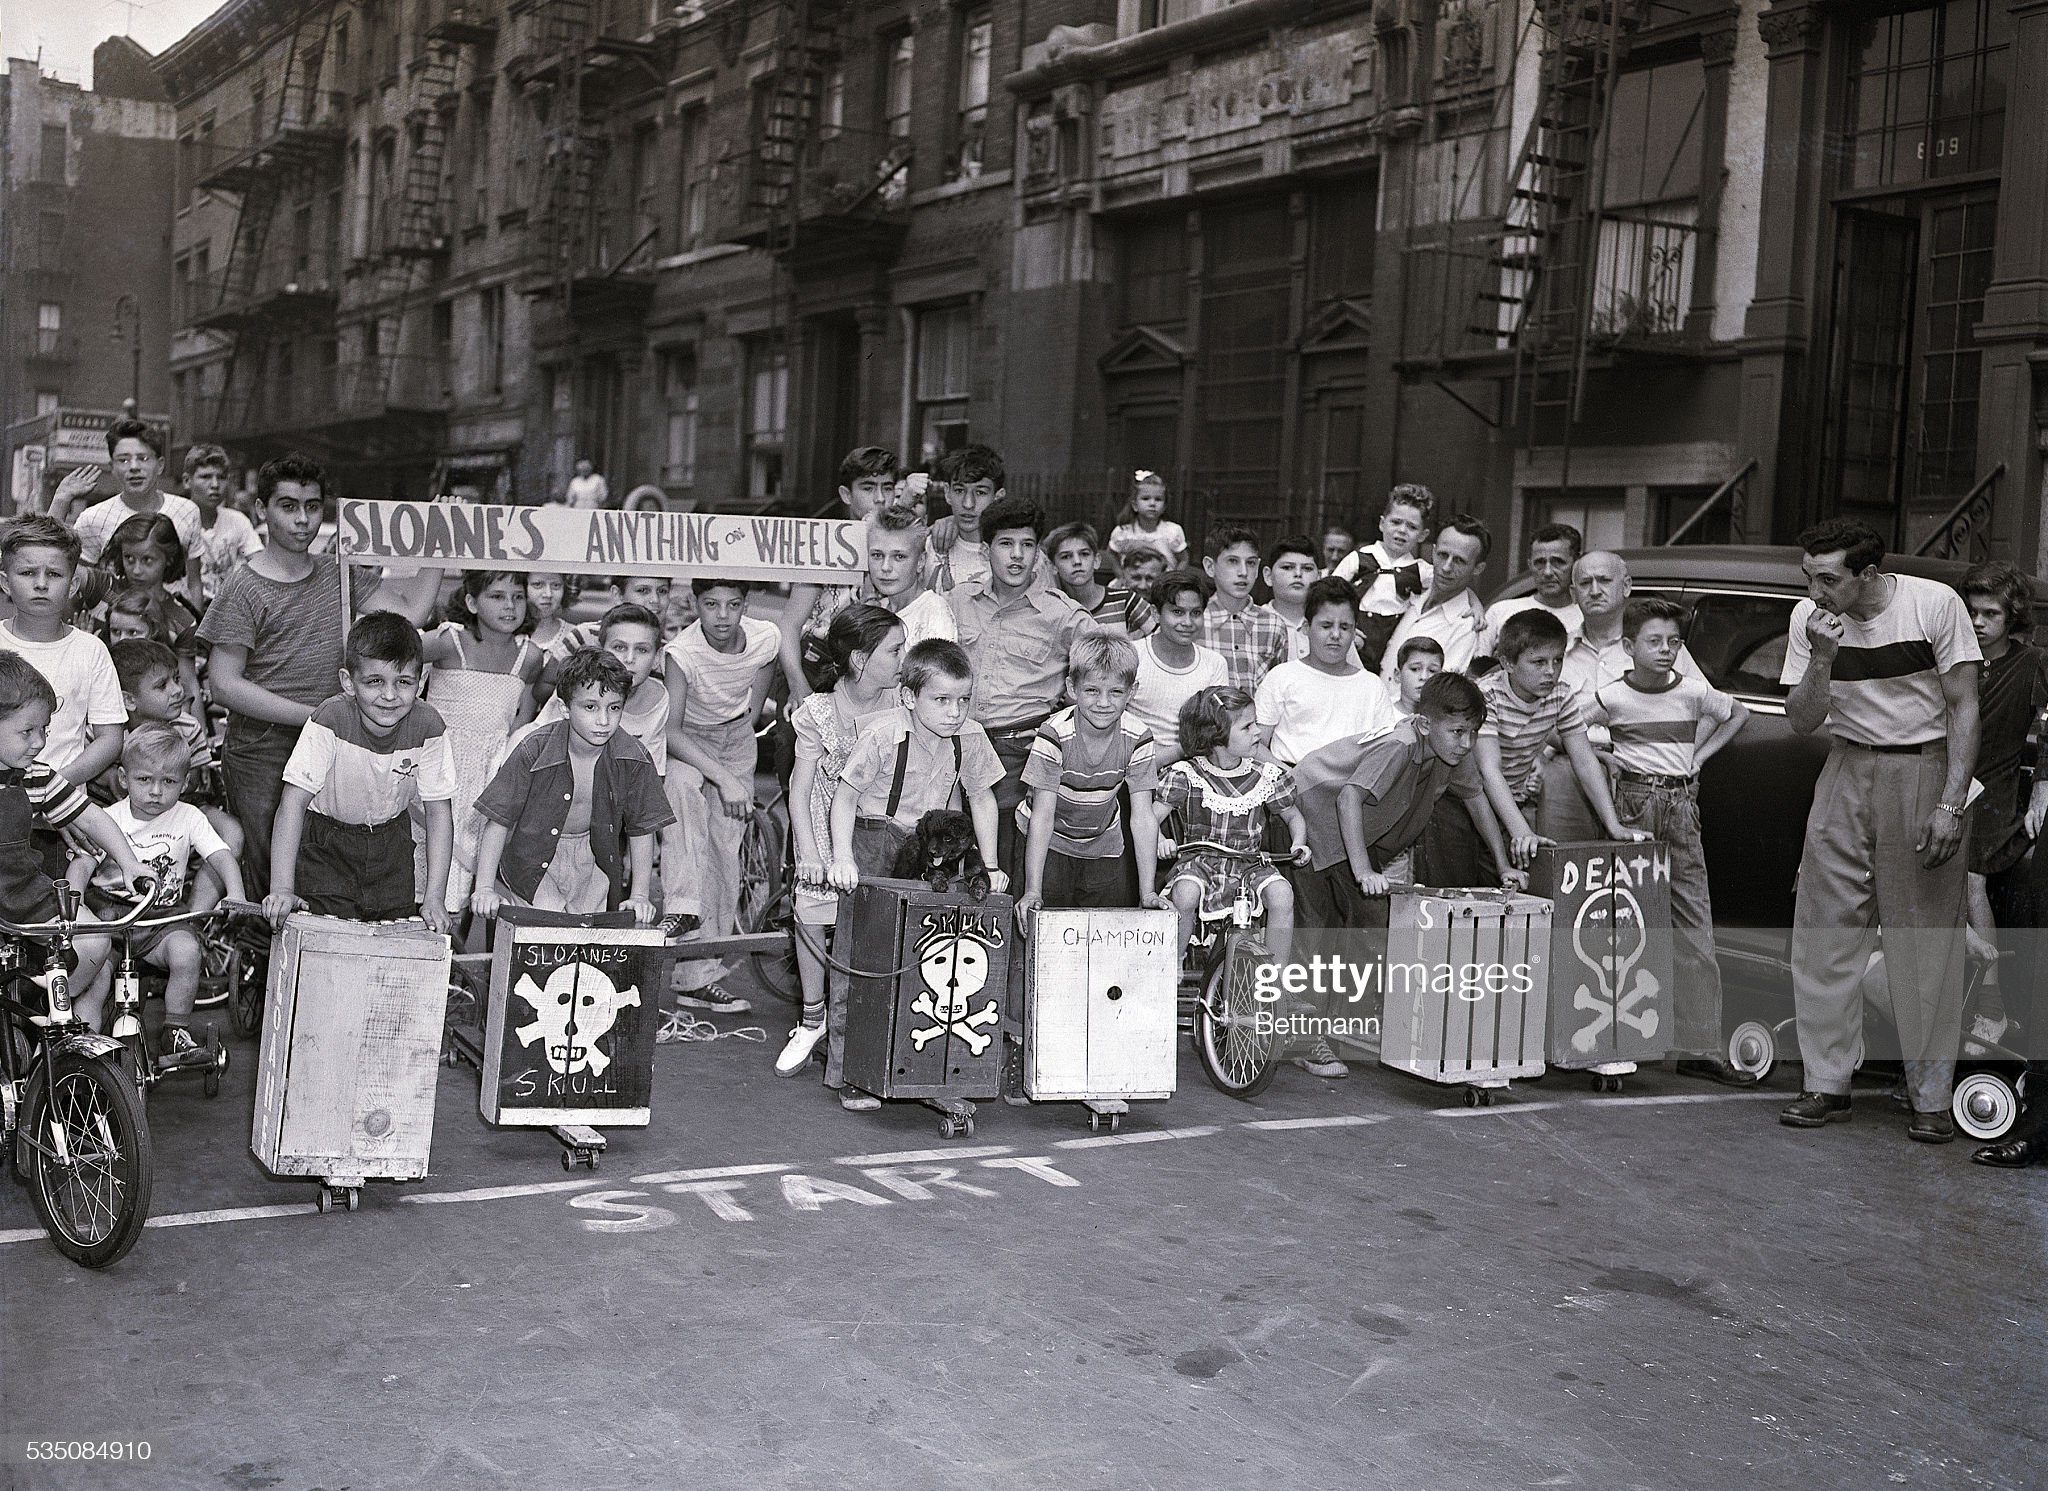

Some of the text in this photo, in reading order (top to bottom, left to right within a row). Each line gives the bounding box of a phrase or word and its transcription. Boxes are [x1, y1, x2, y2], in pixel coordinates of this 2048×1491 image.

[341, 501, 860, 570] SLOANE'S ANYTHING ON WHEELS
[1560, 847, 1671, 894] DEATH
[914, 913, 1004, 949] SKULL
[524, 945, 628, 967] SLOANE'S
[515, 1069, 617, 1097] SKULL
[568, 1155, 1083, 1233] START
